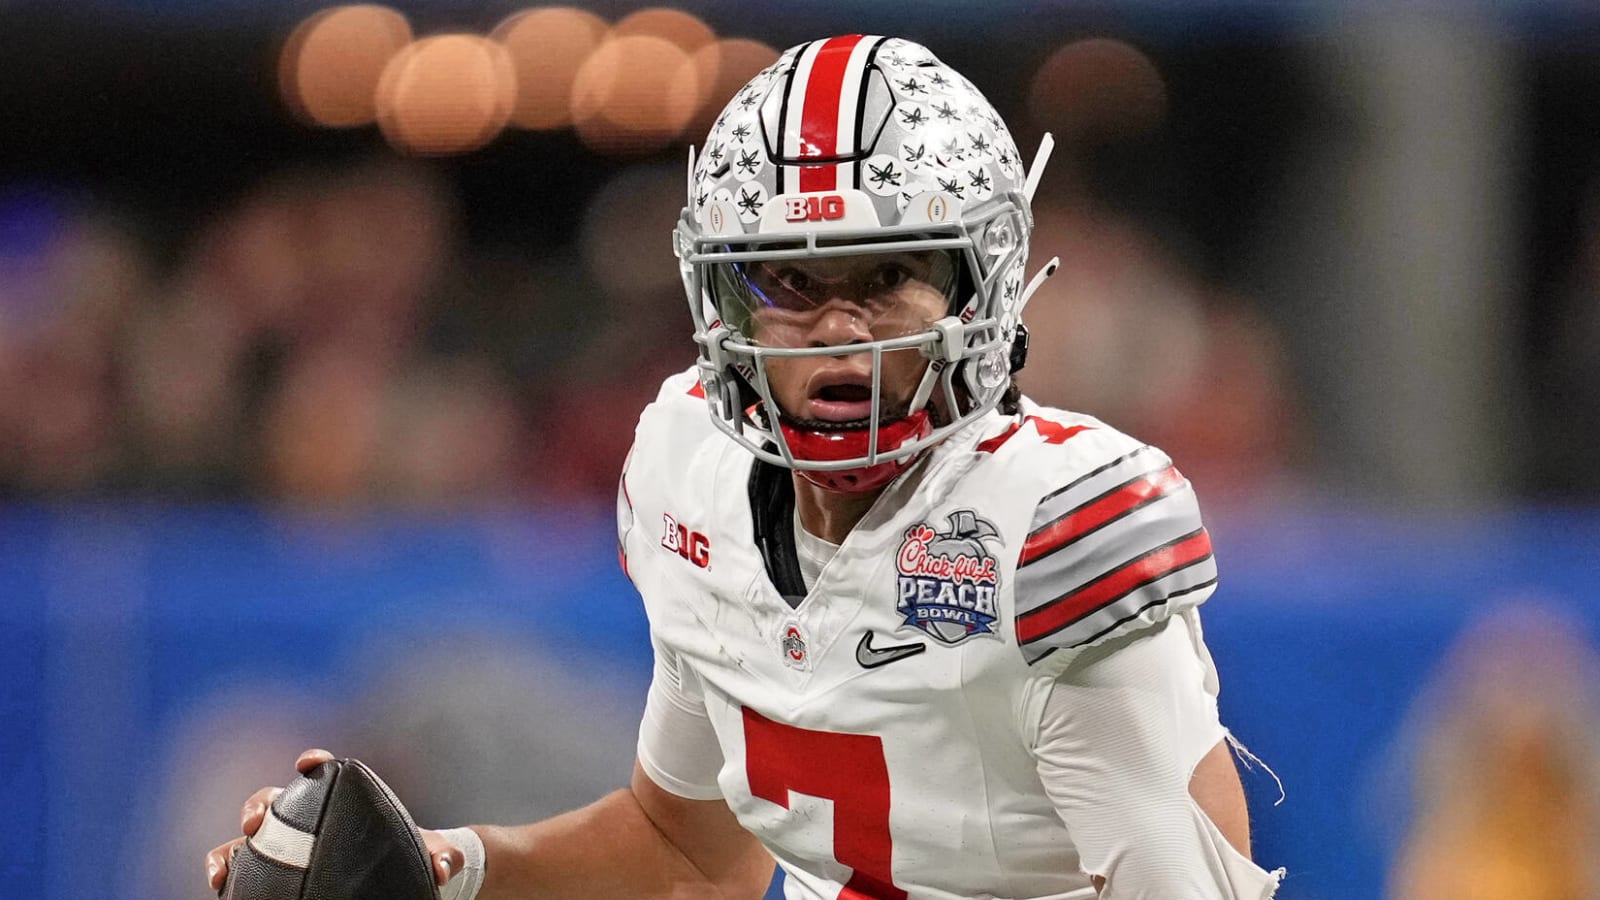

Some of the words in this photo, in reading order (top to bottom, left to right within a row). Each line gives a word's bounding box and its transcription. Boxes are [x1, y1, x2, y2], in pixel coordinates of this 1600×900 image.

[898, 577, 995, 618] PEACH
[917, 608, 976, 624] BOWL
[741, 705, 908, 900] 7
